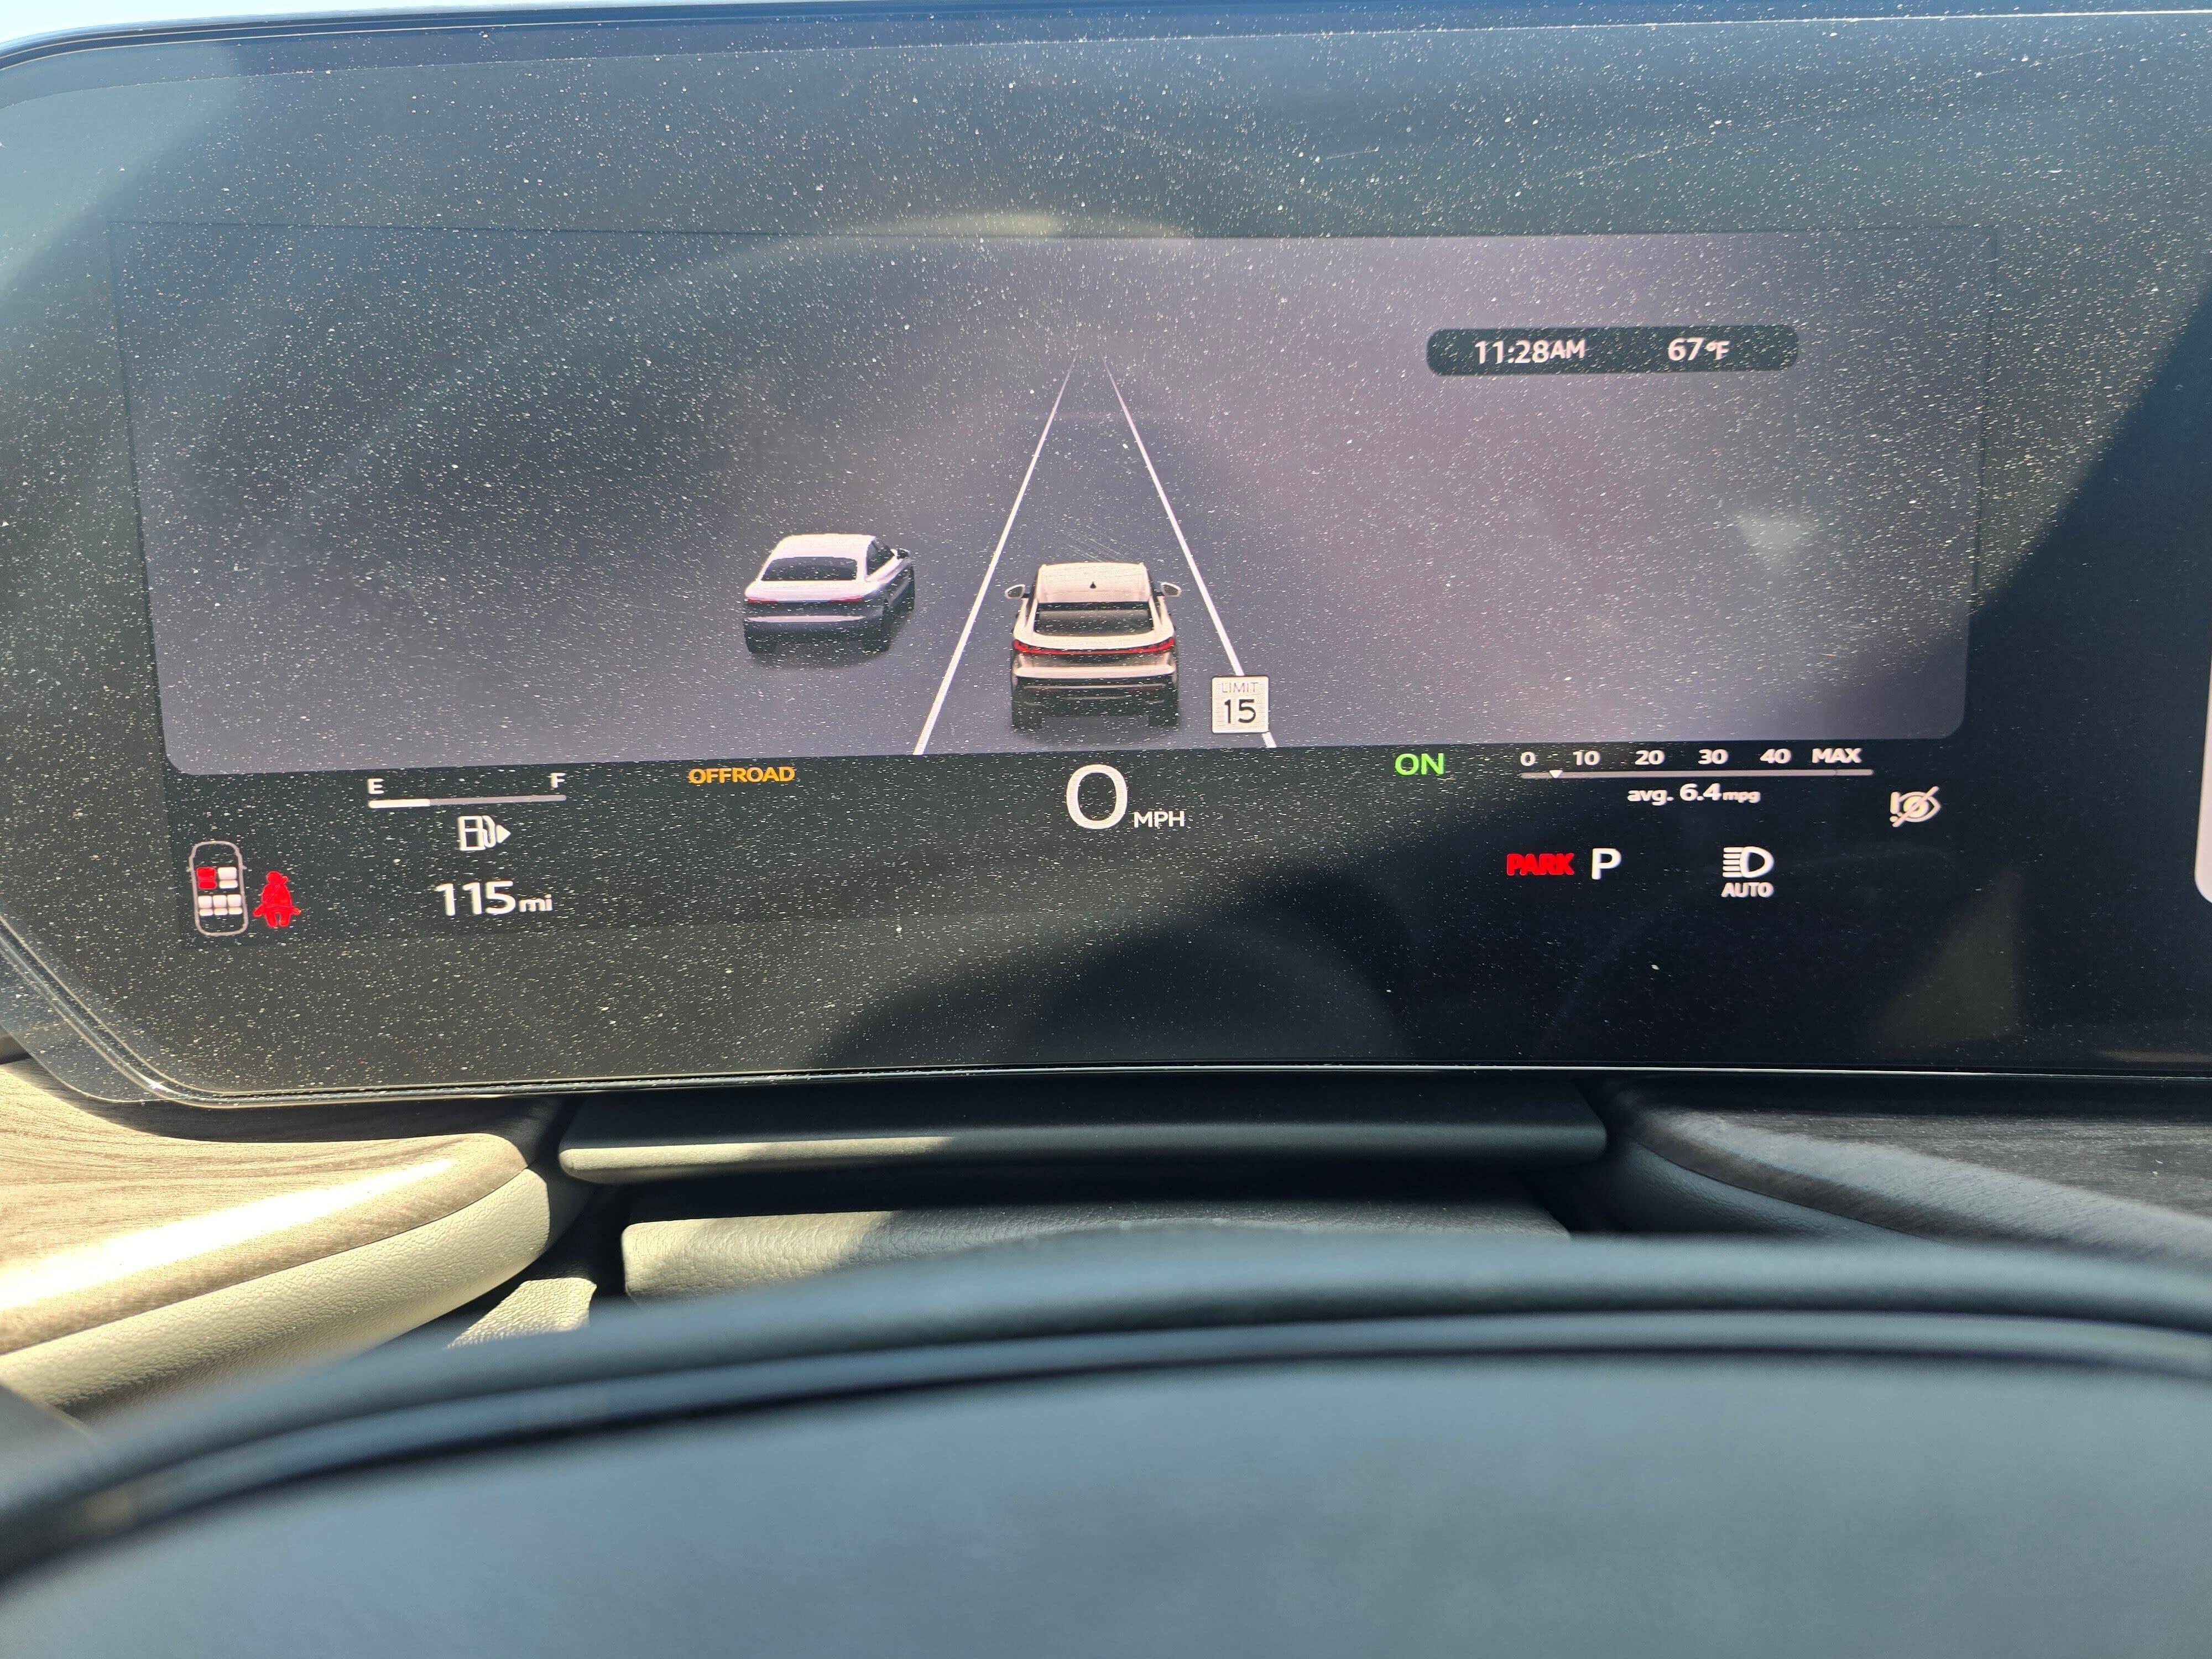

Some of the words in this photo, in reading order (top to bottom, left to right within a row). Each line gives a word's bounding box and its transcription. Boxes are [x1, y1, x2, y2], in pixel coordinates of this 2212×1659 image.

[1473, 338, 1587, 364] 11:28AM
[1220, 681, 1259, 695] LIMIT
[1224, 699, 1256, 724] 15
[1394, 753, 1444, 775] ON
[1521, 752, 1535, 766] 0
[1572, 750, 1599, 765] 10
[1635, 750, 1664, 765] 20
[1698, 749, 1727, 764] 30
[1760, 748, 1790, 764] 40
[1812, 748, 1861, 763] MAX
[550, 773, 566, 789] F
[687, 766, 796, 785] OFFROAD
[367, 778, 385, 795] E
[1066, 764, 1128, 830] 0
[1133, 810, 1185, 828] MPH
[1626, 788, 1673, 806] avg.
[1506, 853, 1575, 877] PARK
[1591, 848, 1623, 880] P
[1721, 881, 1775, 899] AUTO
